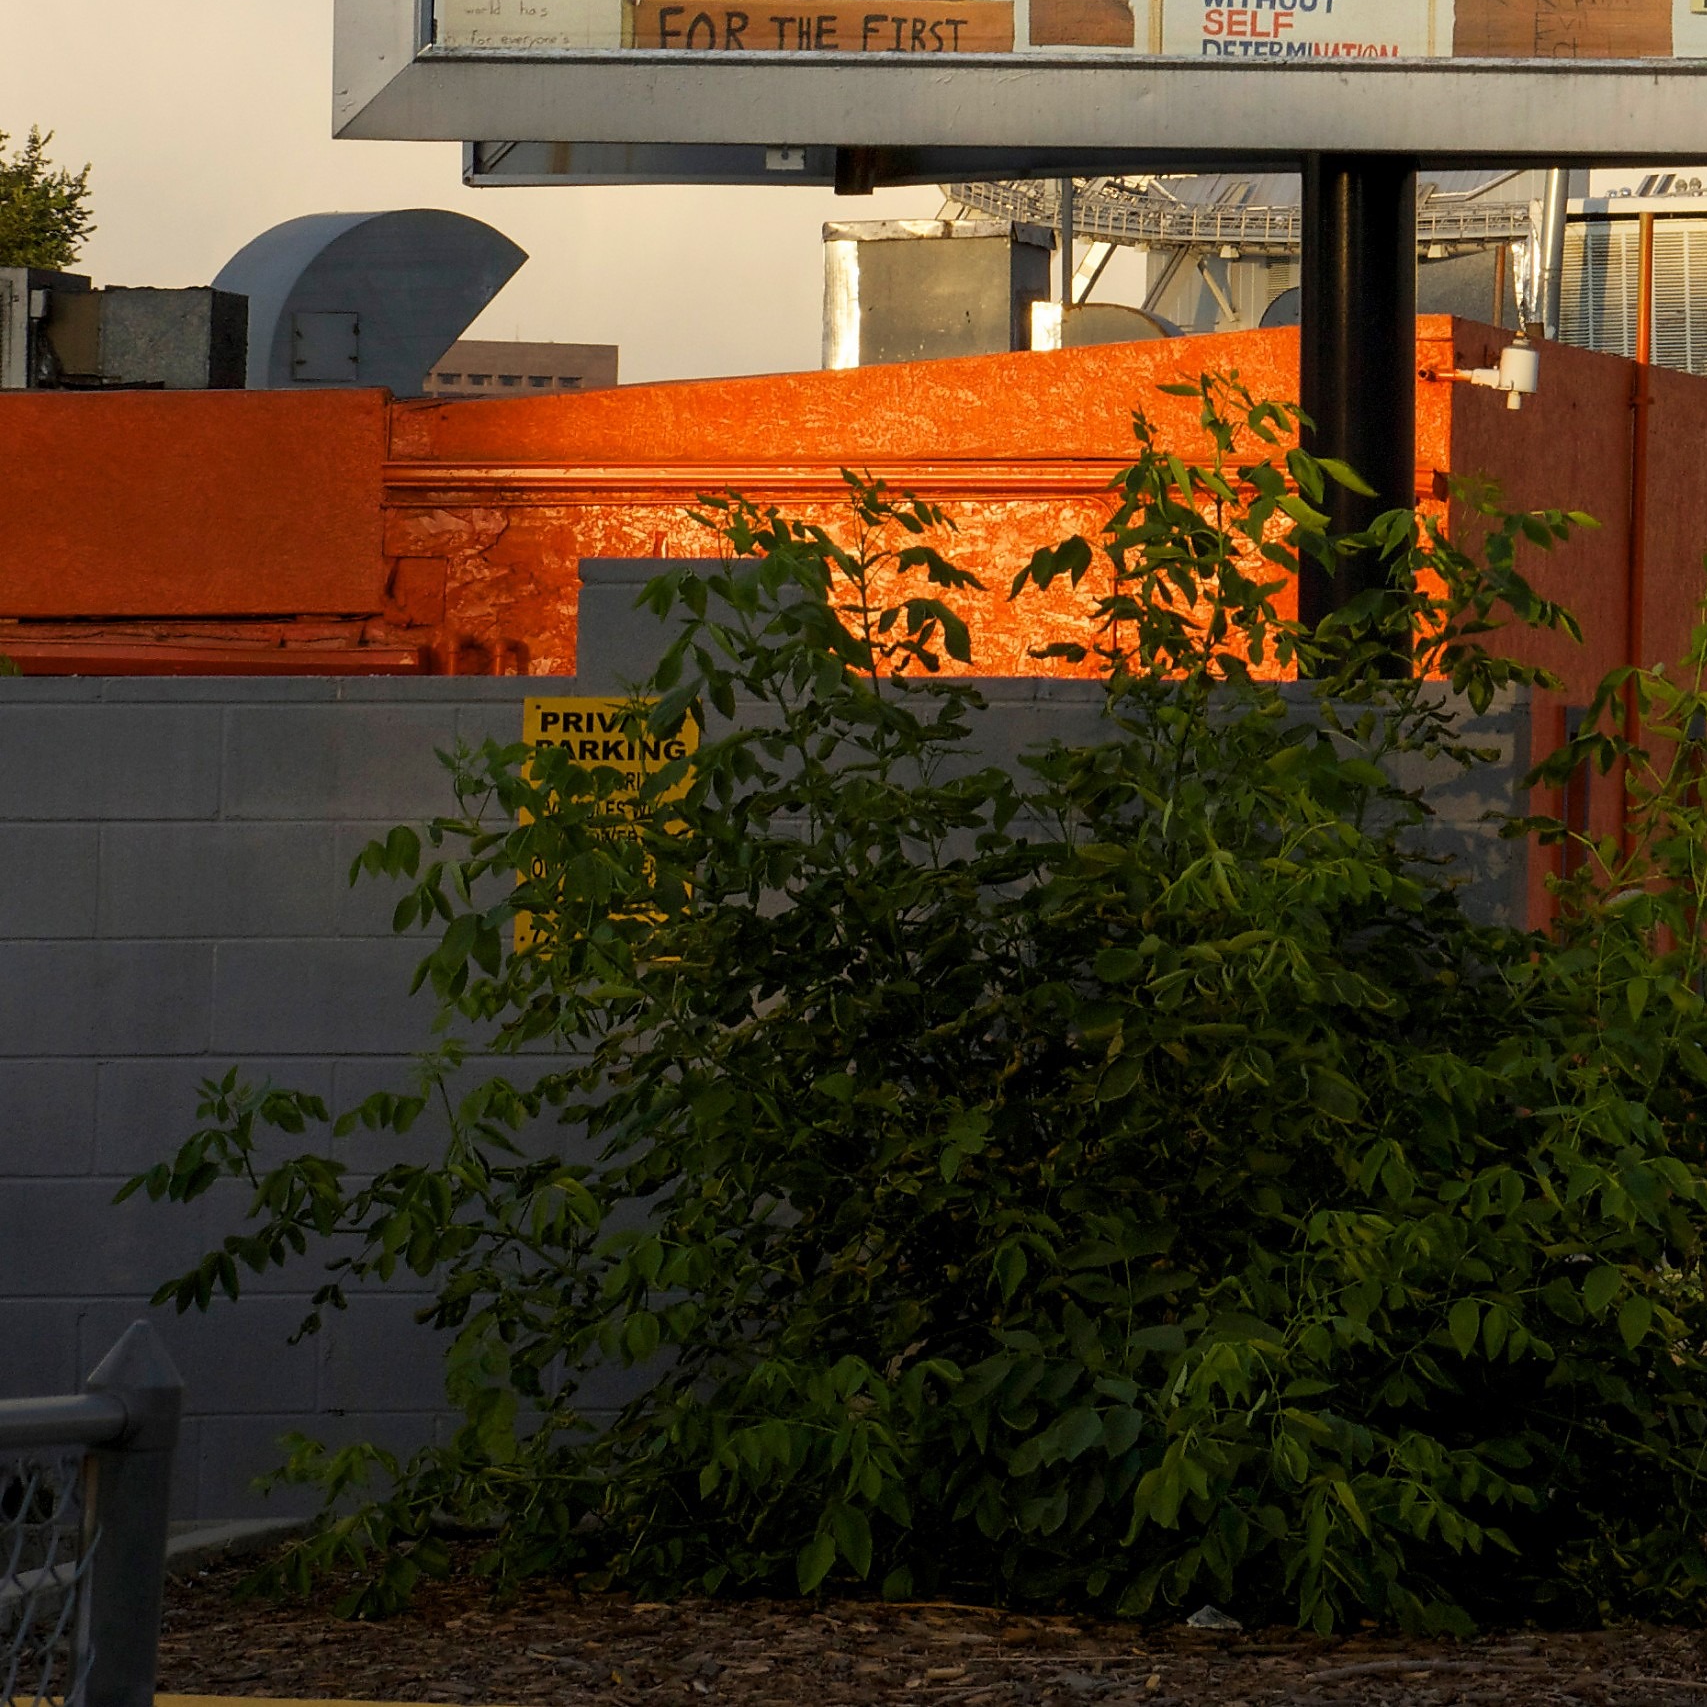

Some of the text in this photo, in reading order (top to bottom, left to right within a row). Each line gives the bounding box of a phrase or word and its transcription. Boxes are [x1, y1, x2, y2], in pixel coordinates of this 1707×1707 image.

[658, 5, 968, 52] FOR THE FIRST
[1203, 9, 1294, 38] SELF
